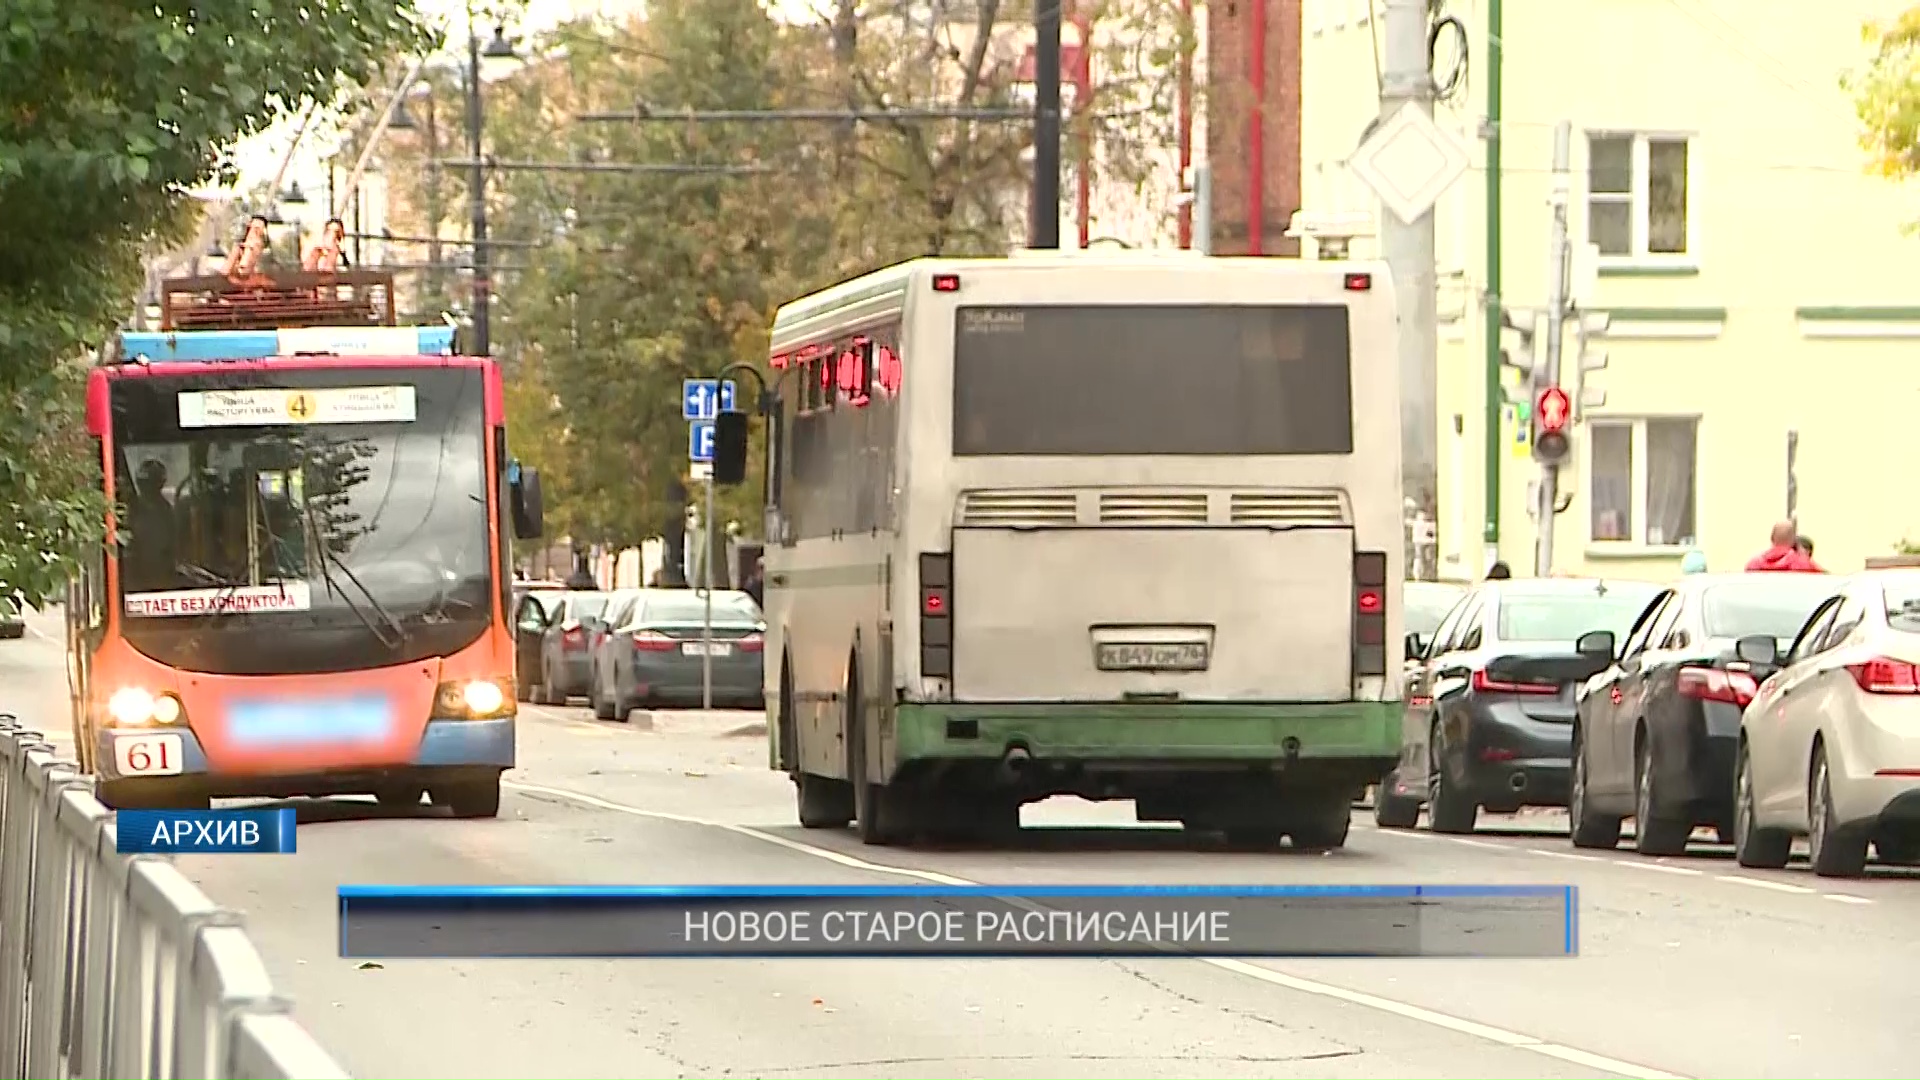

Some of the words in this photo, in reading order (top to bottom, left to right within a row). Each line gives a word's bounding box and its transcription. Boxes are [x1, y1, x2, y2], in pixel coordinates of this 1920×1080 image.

[291, 394, 307, 417] 4
[181, 597, 205, 612] БЕЗ
[209, 594, 296, 611] КОНДУКТОРА
[127, 742, 169, 771] 61
